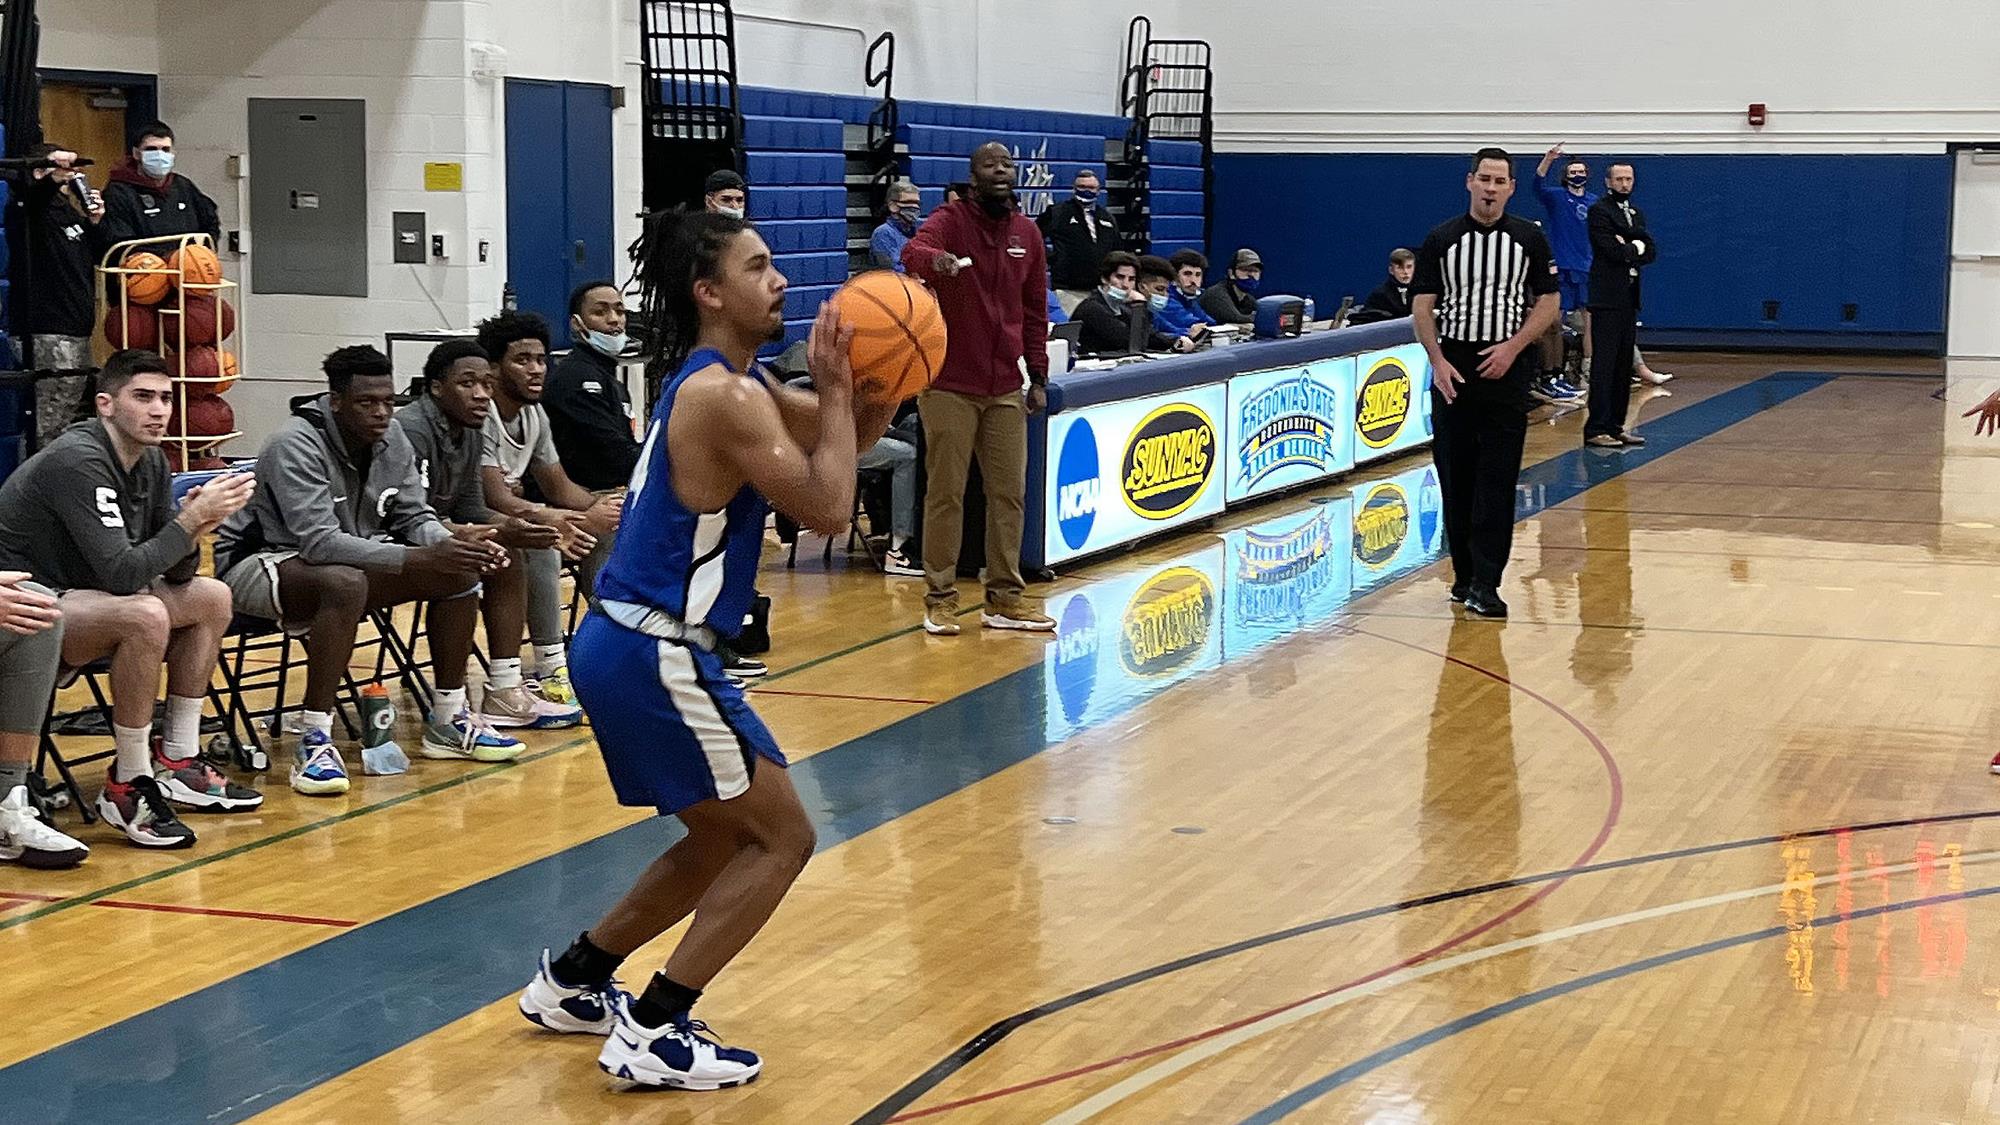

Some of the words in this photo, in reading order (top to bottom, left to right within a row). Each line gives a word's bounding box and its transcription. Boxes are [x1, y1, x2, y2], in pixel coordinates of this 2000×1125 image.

[1240, 385, 1300, 441] FREDONIA
[1300, 377, 1335, 421] STATE
[1125, 425, 1211, 490] SUNYAC
[95, 486, 125, 528] S
[1059, 477, 1100, 521] NCAA
